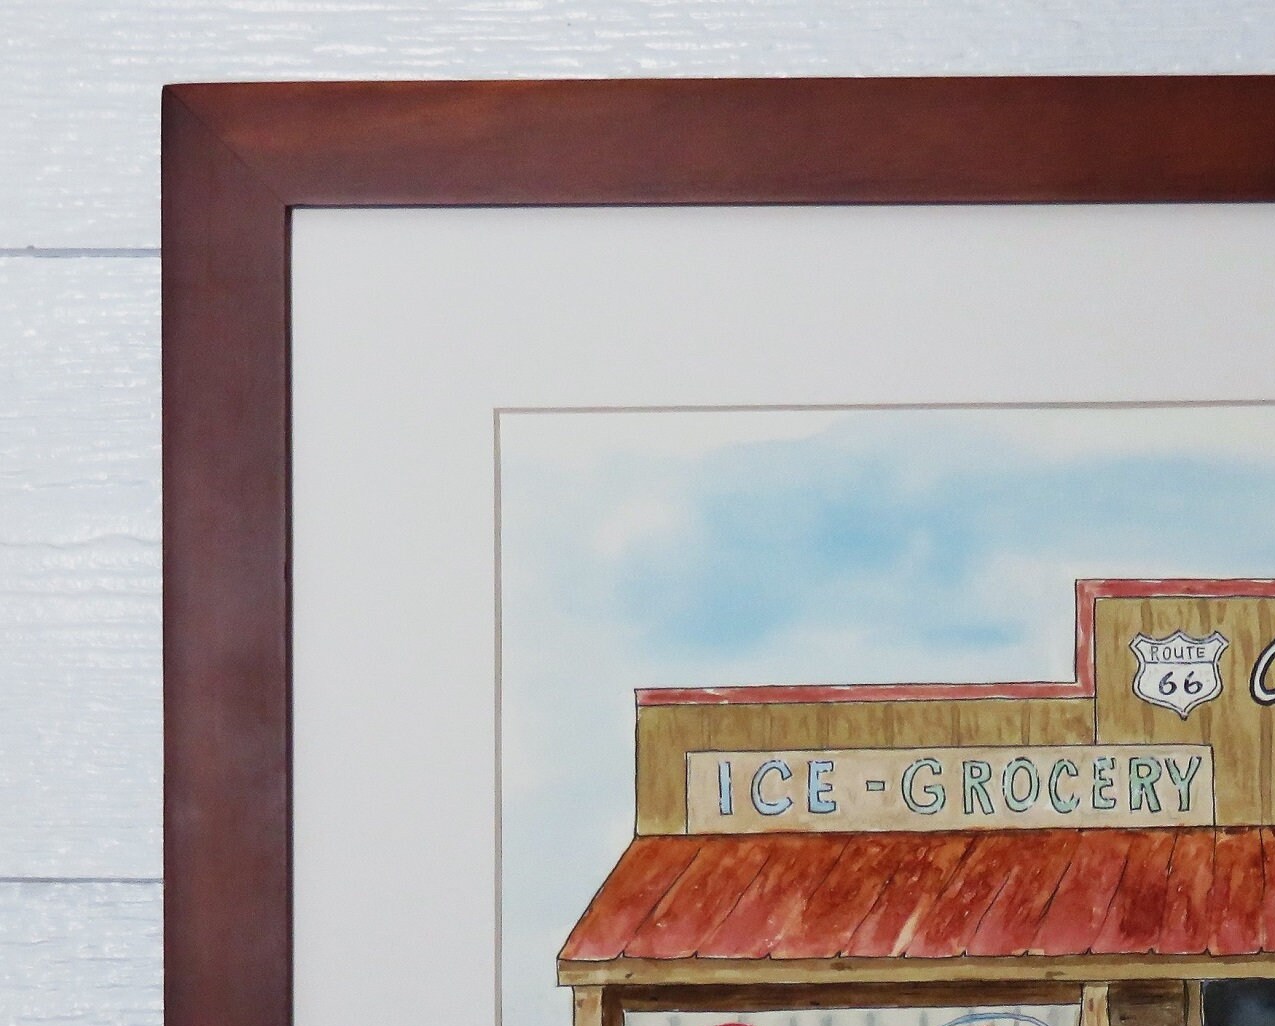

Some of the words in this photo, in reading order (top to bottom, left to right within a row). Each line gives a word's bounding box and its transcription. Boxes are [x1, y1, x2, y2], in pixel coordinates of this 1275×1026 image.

[1149, 645, 1206, 662] ROUTE
[1158, 670, 1204, 696] 66
[717, 759, 838, 816] ICE
[900, 756, 1202, 815] GROCERY
